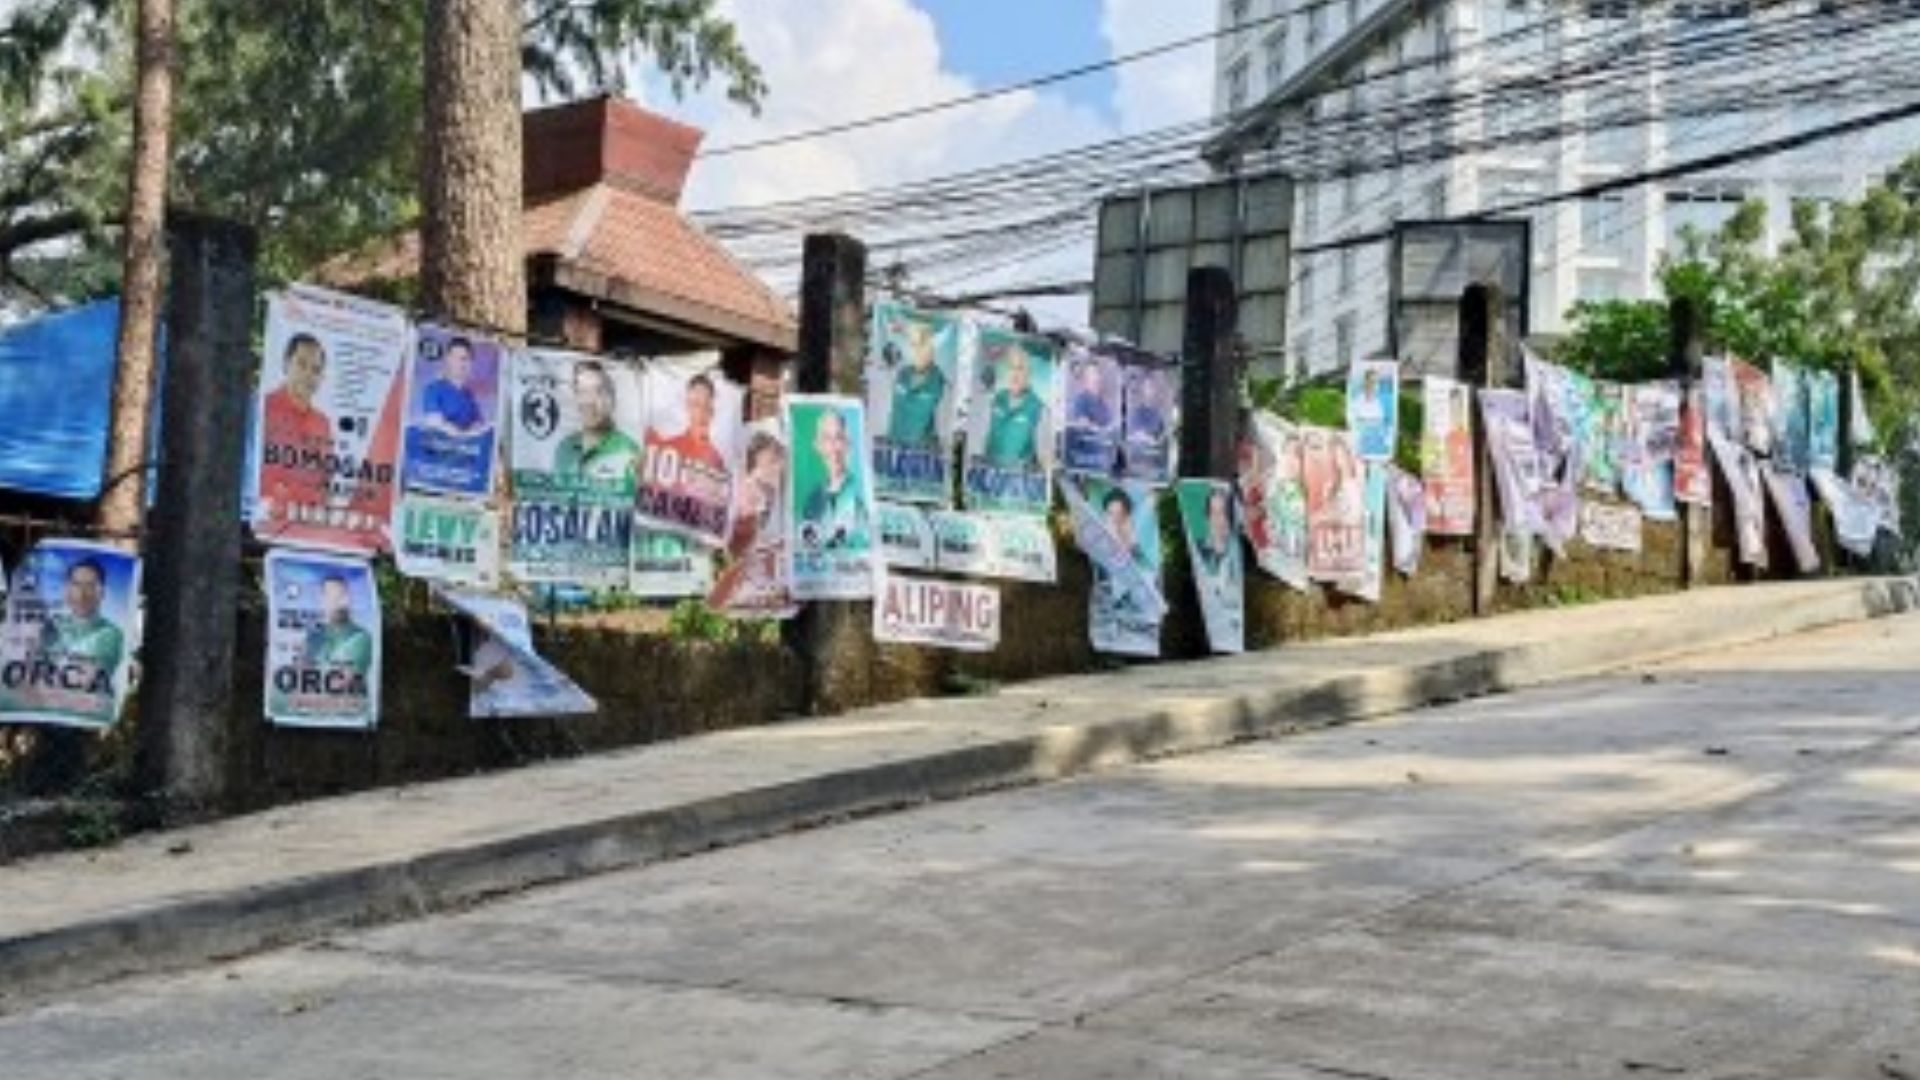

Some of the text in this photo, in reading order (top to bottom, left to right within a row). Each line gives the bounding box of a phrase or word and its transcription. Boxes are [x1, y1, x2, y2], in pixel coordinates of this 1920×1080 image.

[531, 393, 551, 434] 3
[881, 580, 995, 630] ALIPING
[2, 658, 115, 697] ORCA
[273, 664, 368, 696] ORCA
